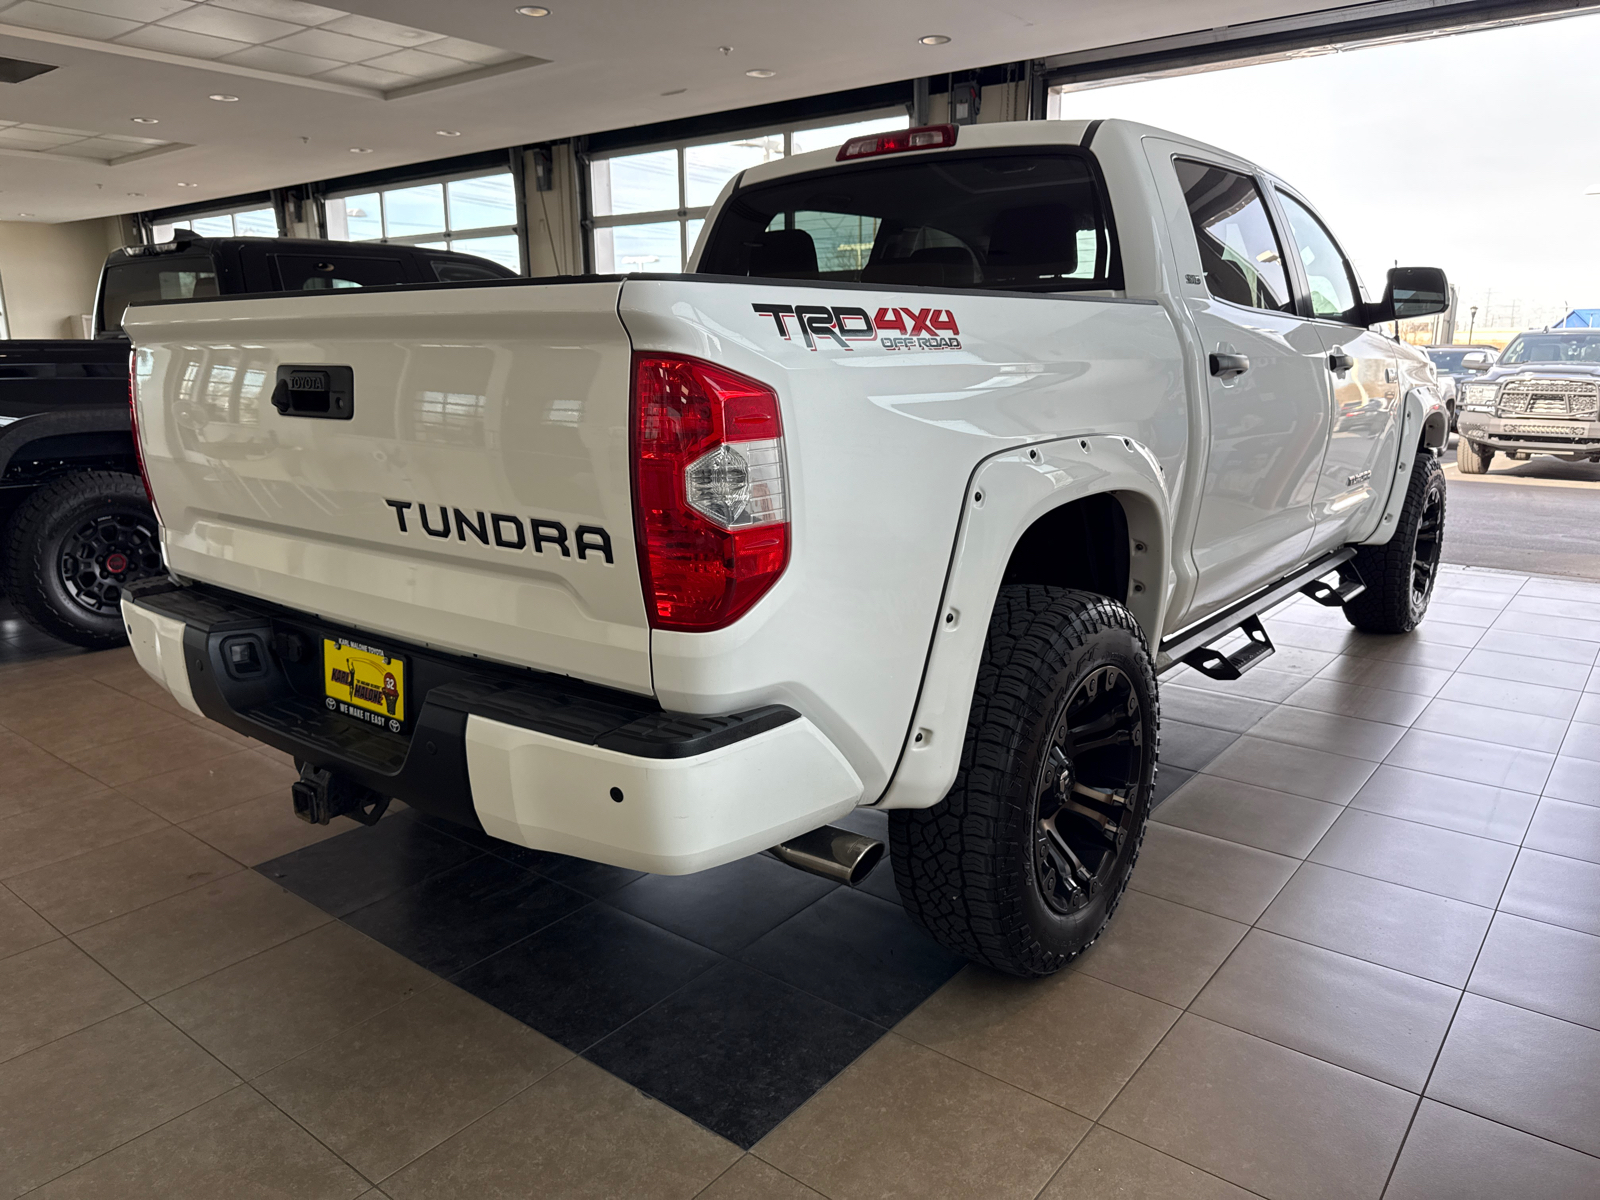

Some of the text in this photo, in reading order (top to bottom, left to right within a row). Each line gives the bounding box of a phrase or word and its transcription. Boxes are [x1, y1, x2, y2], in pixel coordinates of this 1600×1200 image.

[751, 303, 877, 351] TRD
[880, 337, 962, 351] OFF ROAD
[290, 376, 323, 390] TOYOTA
[384, 499, 614, 565] TUNDRA
[331, 668, 350, 686] KARL
[385, 677, 395, 690] 32
[354, 683, 383, 705] MALONE
[340, 703, 385, 726] WE MAKE IT EASY
